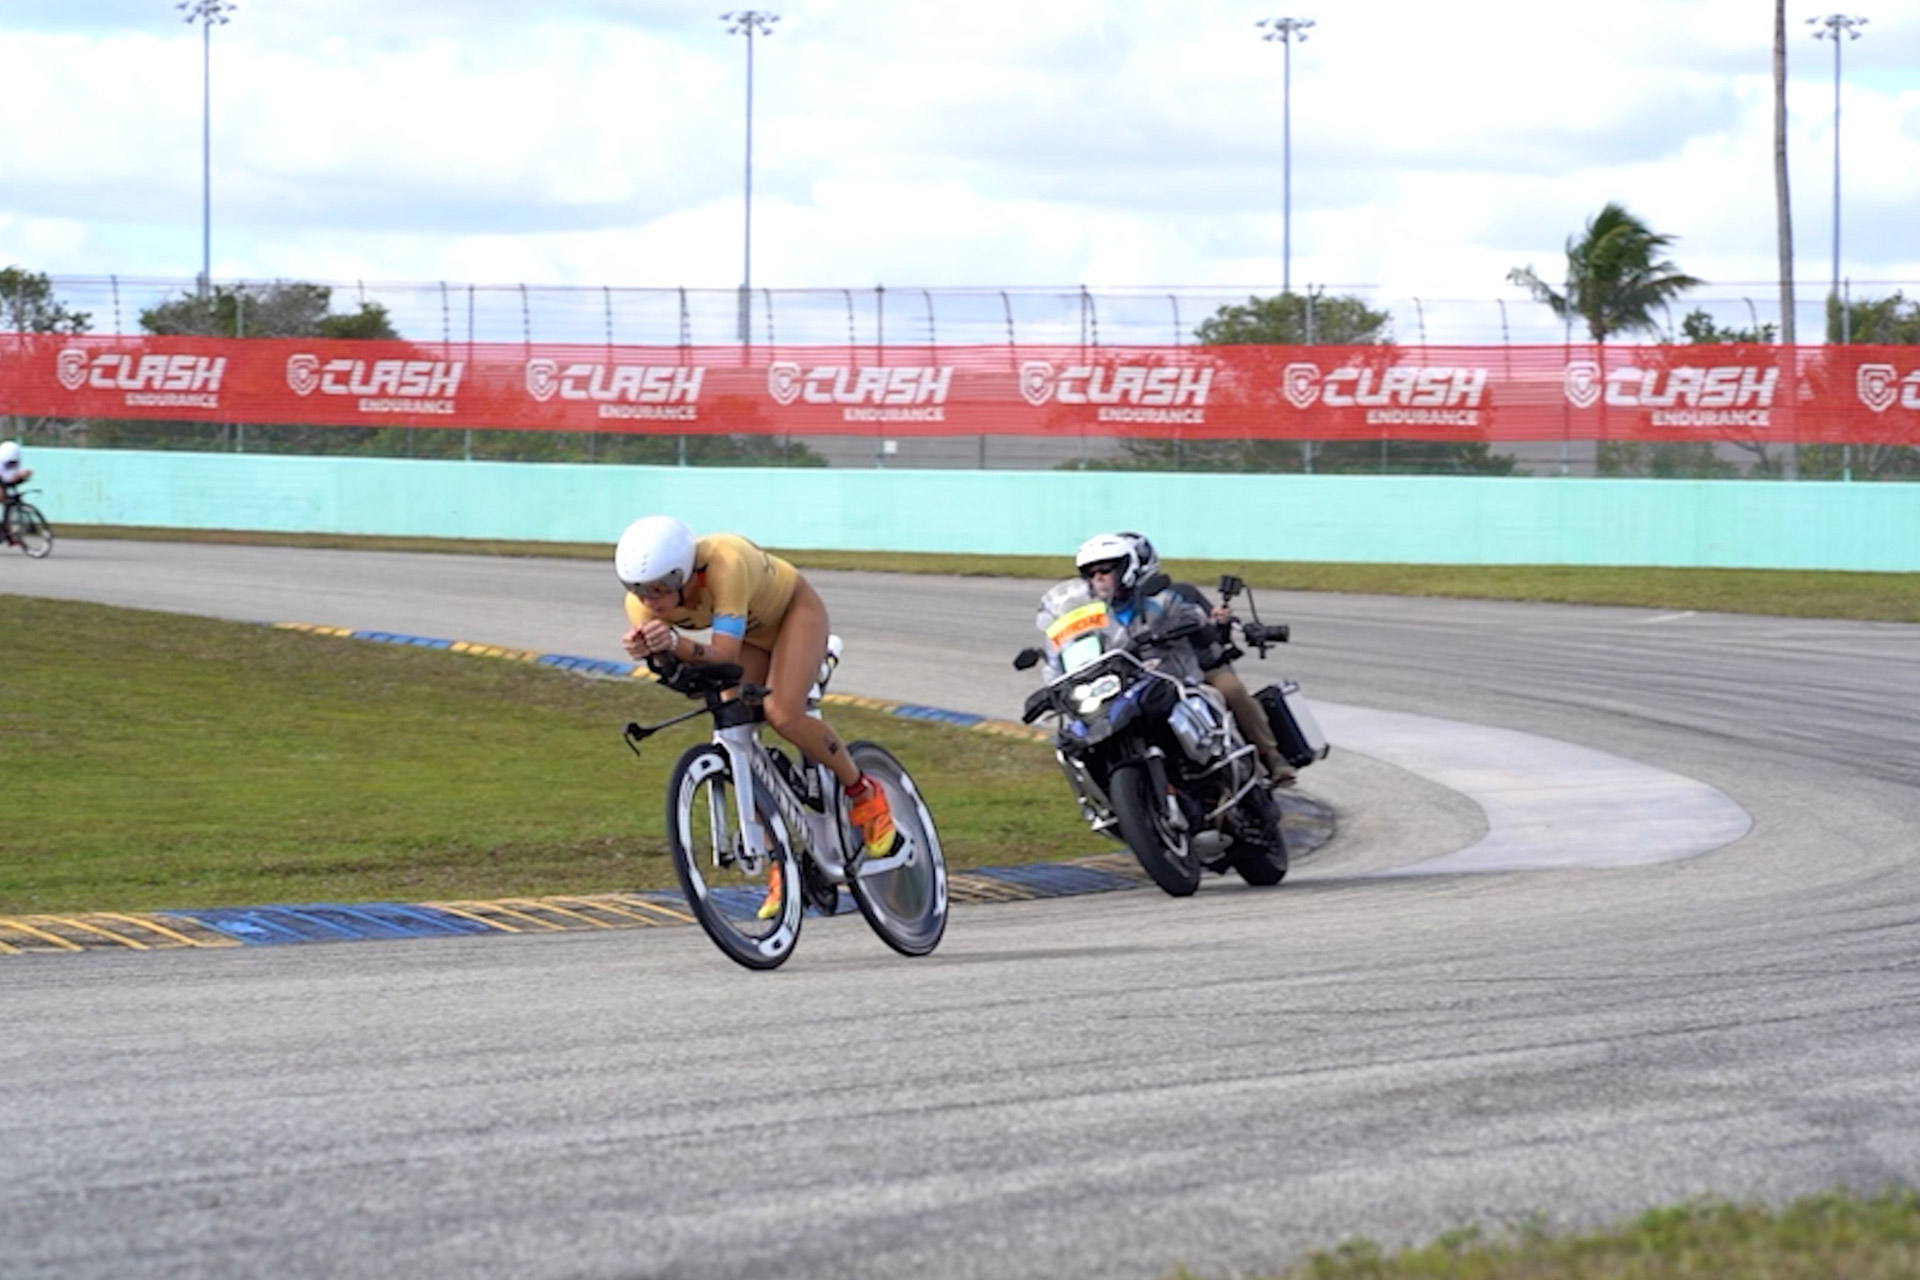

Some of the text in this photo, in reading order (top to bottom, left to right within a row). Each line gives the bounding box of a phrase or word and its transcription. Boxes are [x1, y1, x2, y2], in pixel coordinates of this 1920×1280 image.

[89, 353, 226, 391] CLASH
[320, 359, 463, 397] CLASH
[558, 364, 706, 403] CLASH
[803, 366, 953, 405] CLASH
[1057, 365, 1213, 406] CLASH
[126, 392, 219, 408] ENDURANCE
[1322, 366, 1486, 408] CLASH
[1602, 366, 1778, 407] CLASH
[358, 398, 455, 414] ENDURANCE
[598, 404, 698, 421] ENDURANCE
[843, 406, 945, 423] ENDURANCE
[1097, 407, 1205, 424] ENDURANCE
[1366, 409, 1480, 426] ENDURANCE
[1651, 409, 1772, 427] ENDURANCE
